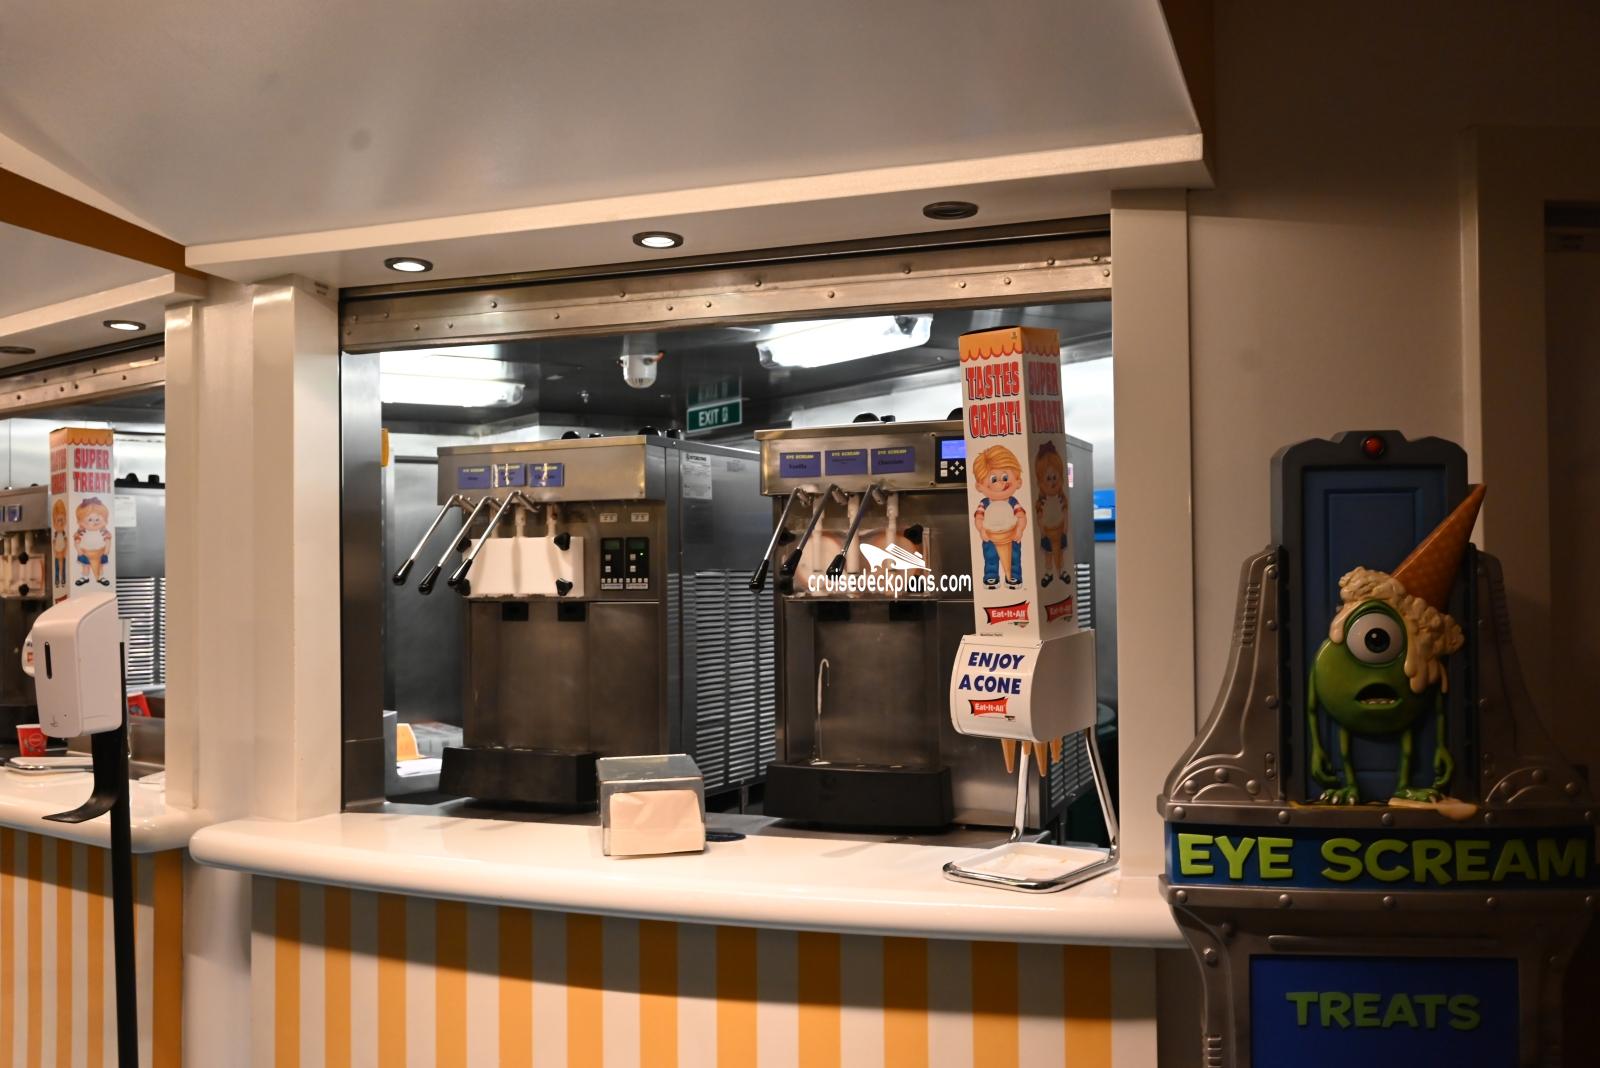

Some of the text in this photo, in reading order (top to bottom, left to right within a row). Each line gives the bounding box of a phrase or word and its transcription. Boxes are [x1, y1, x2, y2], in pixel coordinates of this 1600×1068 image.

[966, 361, 1020, 400] TASTES
[1028, 361, 1060, 396] SUPER
[698, 408, 720, 427] EXIT
[969, 400, 1023, 439] GREAT!
[74, 447, 110, 470] SUPER
[73, 471, 112, 494] TREAT!
[968, 651, 1025, 672] ENJOY
[958, 674, 1022, 695] A CONE
[1177, 832, 1589, 886] EYE SCREAM
[1284, 991, 1482, 1031] TREATS
